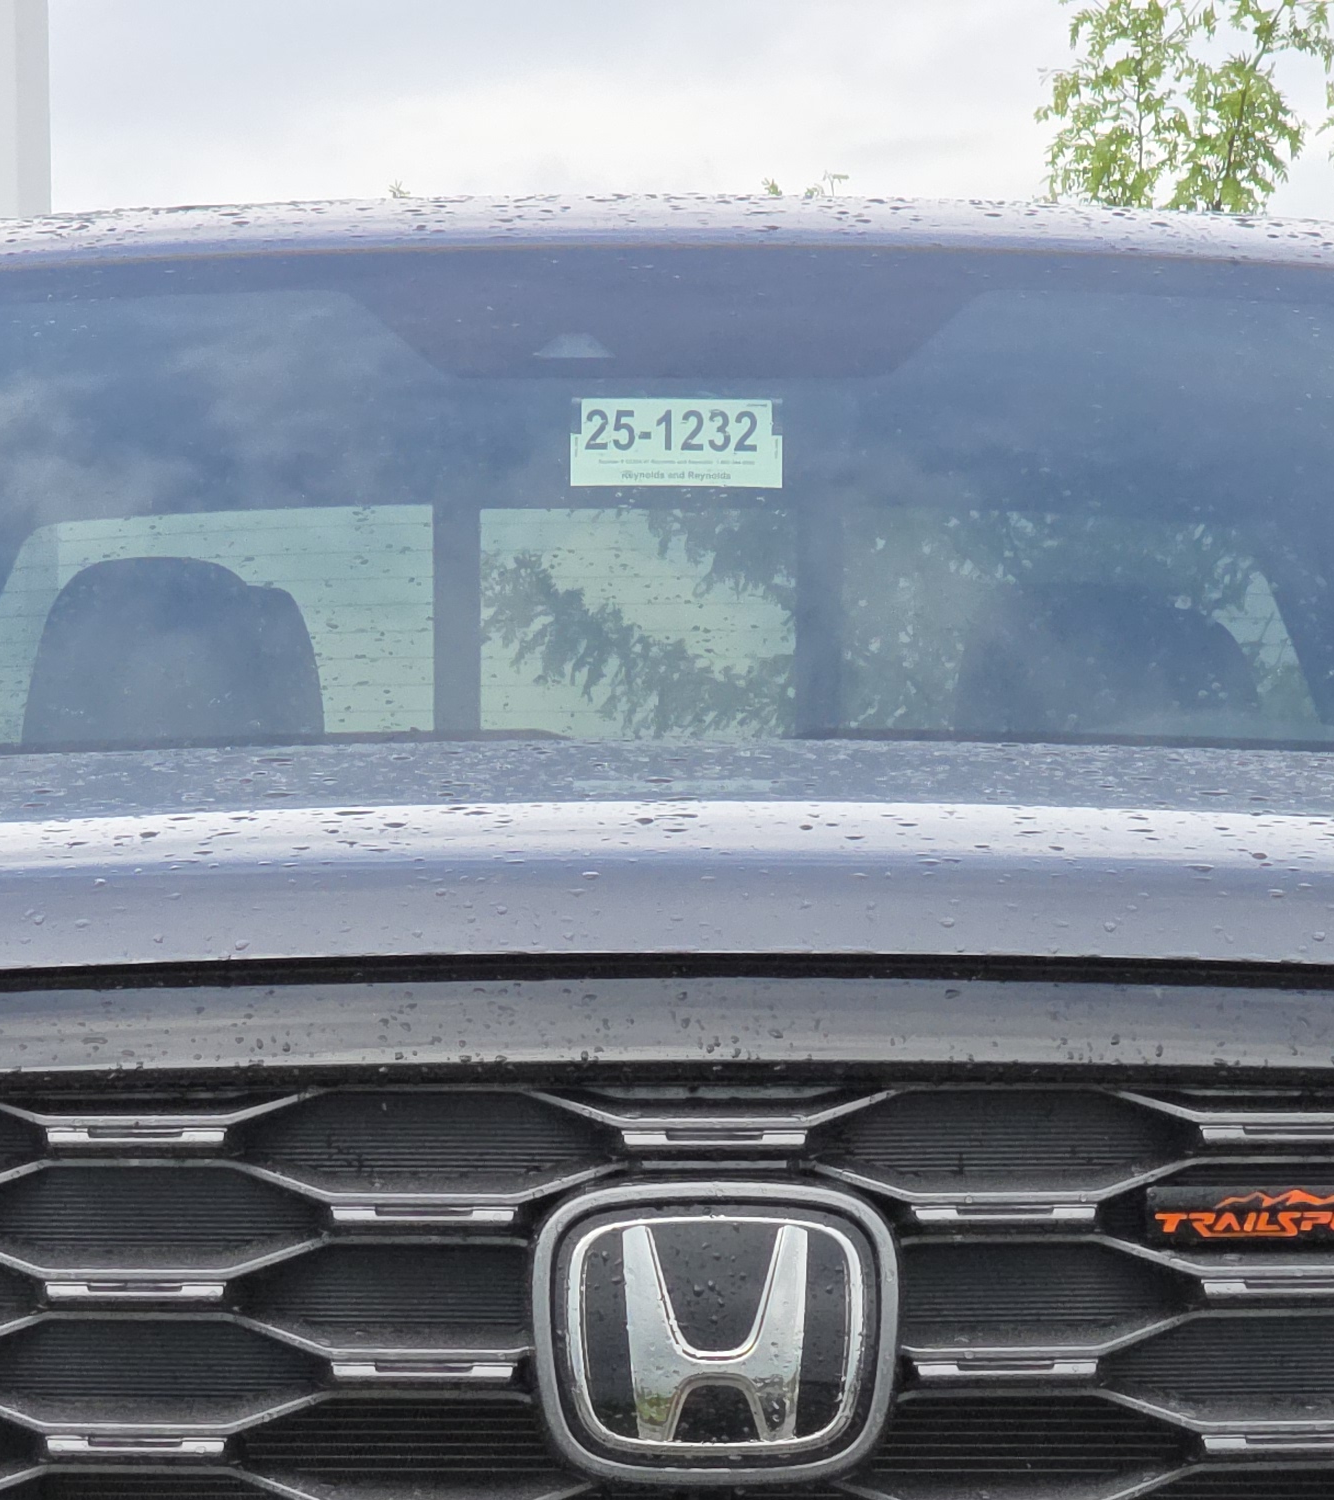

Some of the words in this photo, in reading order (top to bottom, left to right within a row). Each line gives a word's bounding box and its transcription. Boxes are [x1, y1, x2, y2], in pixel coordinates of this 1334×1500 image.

[584, 408, 758, 453] 25-1232
[622, 470, 665, 482] Reynolds
[667, 471, 685, 480] and
[688, 470, 731, 482] Reynolds
